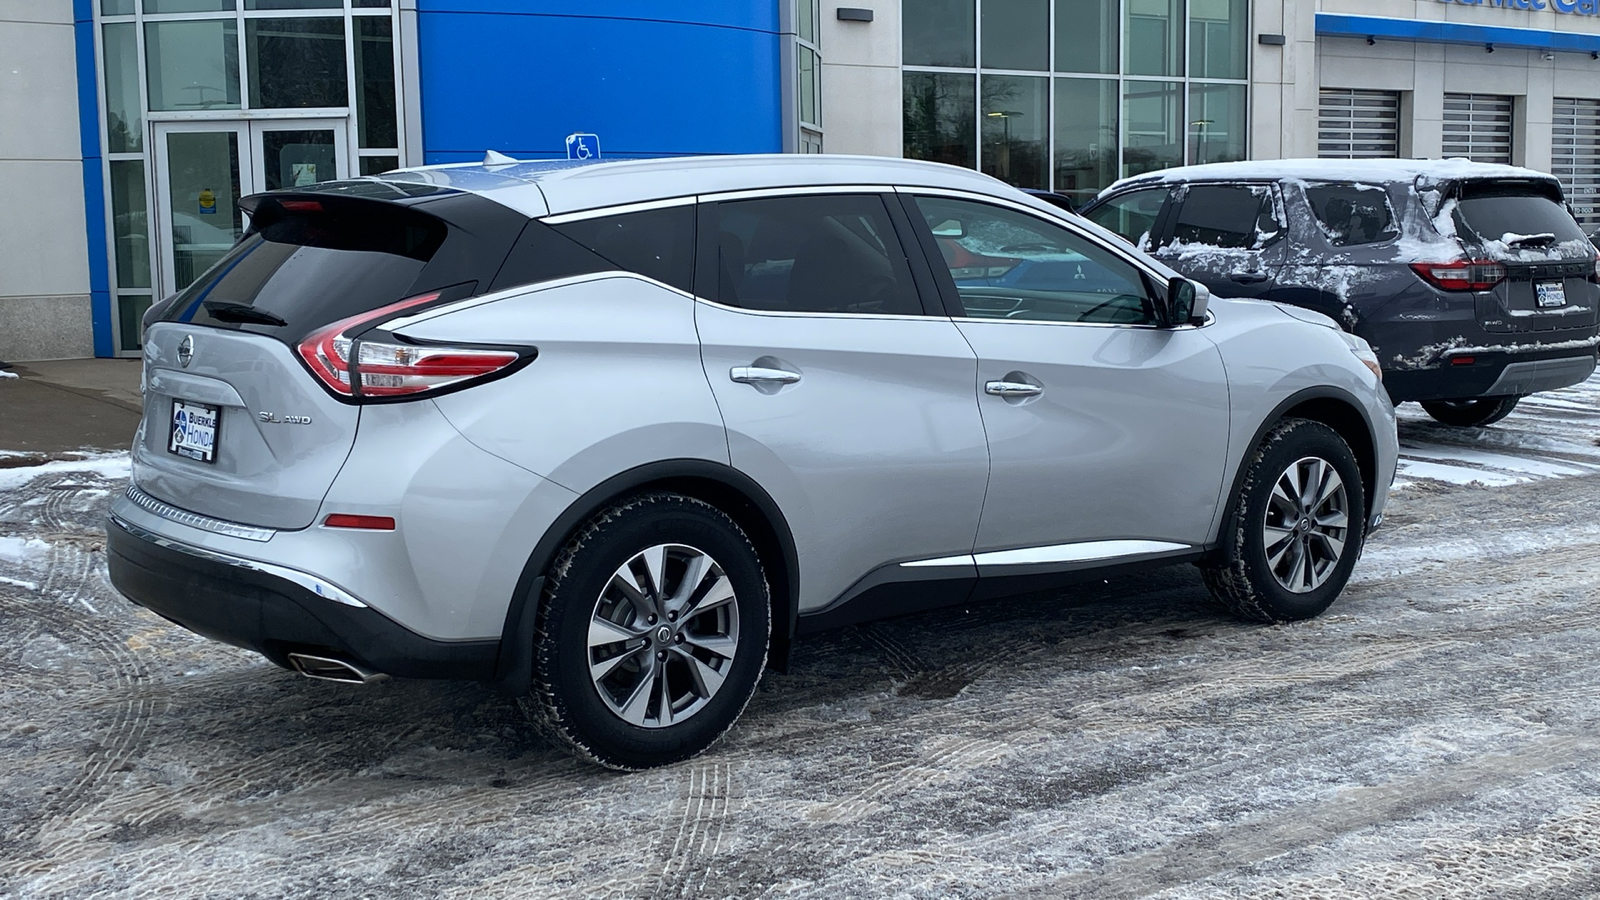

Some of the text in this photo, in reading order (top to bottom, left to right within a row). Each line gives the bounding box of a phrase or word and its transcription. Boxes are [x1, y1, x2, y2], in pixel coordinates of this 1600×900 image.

[188, 411, 216, 428] BUERKLE
[259, 411, 312, 425] SL AWD
